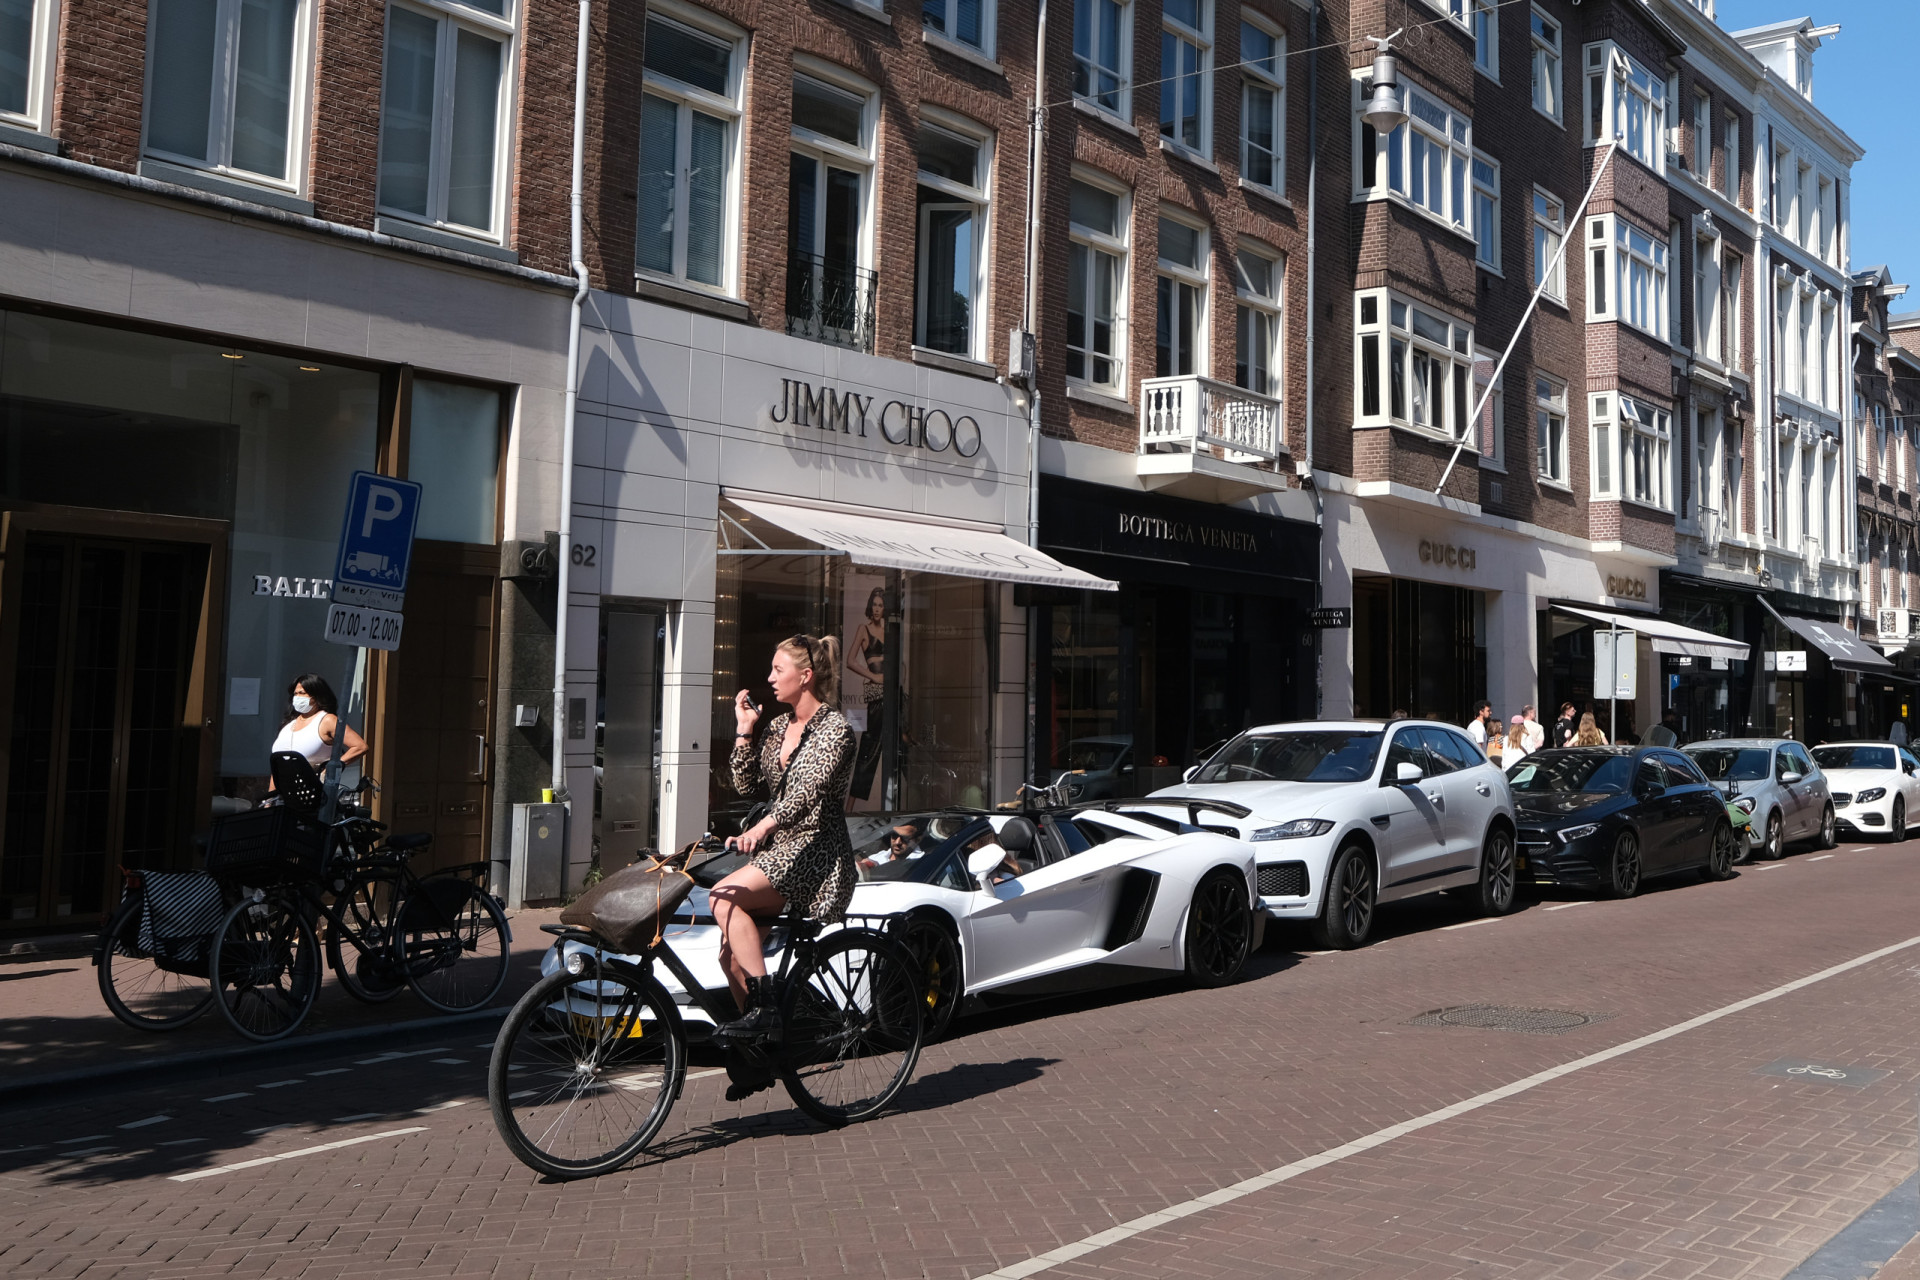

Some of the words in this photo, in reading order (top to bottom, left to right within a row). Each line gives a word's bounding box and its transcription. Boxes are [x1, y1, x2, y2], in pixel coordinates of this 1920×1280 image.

[771, 378, 874, 437] JIMMY
[880, 400, 982, 457] CHOO
[362, 484, 403, 538] P
[1119, 513, 1194, 543] BOTTEGA
[1200, 526, 1257, 553] VENETA
[571, 544, 596, 567] 62
[810, 528, 937, 560] JIMMY
[930, 546, 1063, 572] CHOO
[1418, 540, 1476, 570] GUCCI
[342, 585, 356, 594] Ma
[1606, 574, 1647, 598] GUCCI
[332, 610, 361, 637] 07.00
[369, 616, 399, 642] 12.00h
[1311, 611, 1344, 619] BOTTEGA
[1313, 618, 1342, 626] VENETA
[1302, 633, 1313, 647] 60
